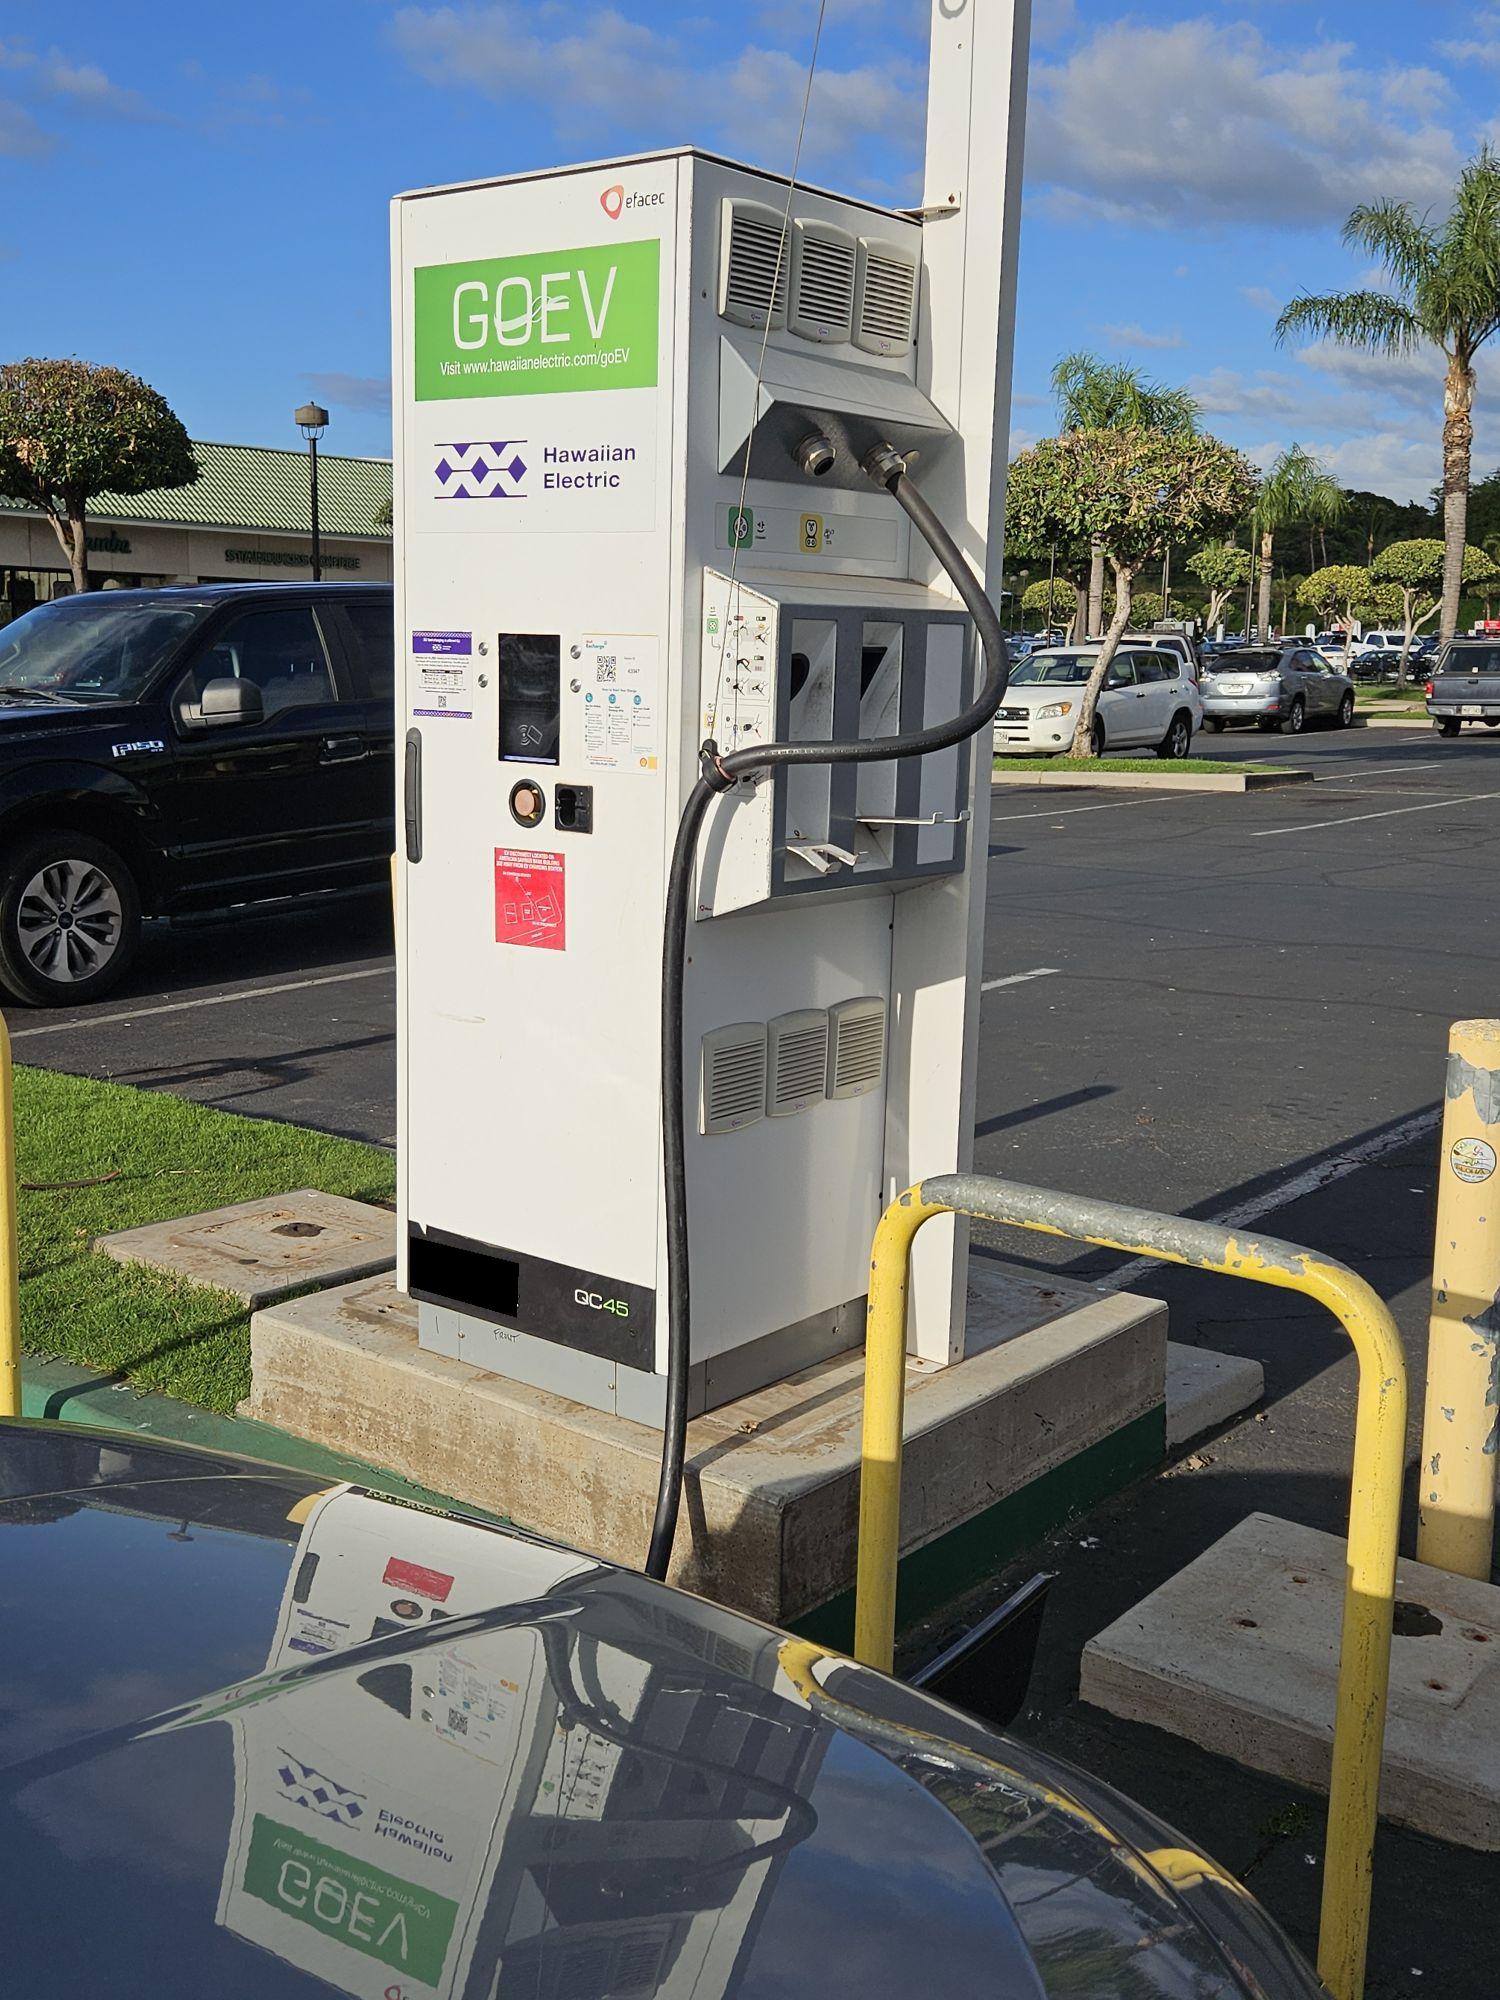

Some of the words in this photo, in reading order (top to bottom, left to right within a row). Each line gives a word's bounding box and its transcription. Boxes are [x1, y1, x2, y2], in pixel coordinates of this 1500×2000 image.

[625, 191, 665, 209] efacec
[453, 266, 617, 350] GOEV
[440, 360, 461, 376] Visit
[463, 348, 630, 374] www.hawaiianelectric.com/goEV
[543, 445, 636, 464] Hawaiian
[543, 471, 620, 489] Electric
[85, 531, 132, 554] amba
[574, 1289, 629, 1317] QC45
[493, 1328, 521, 1343] FRONT
